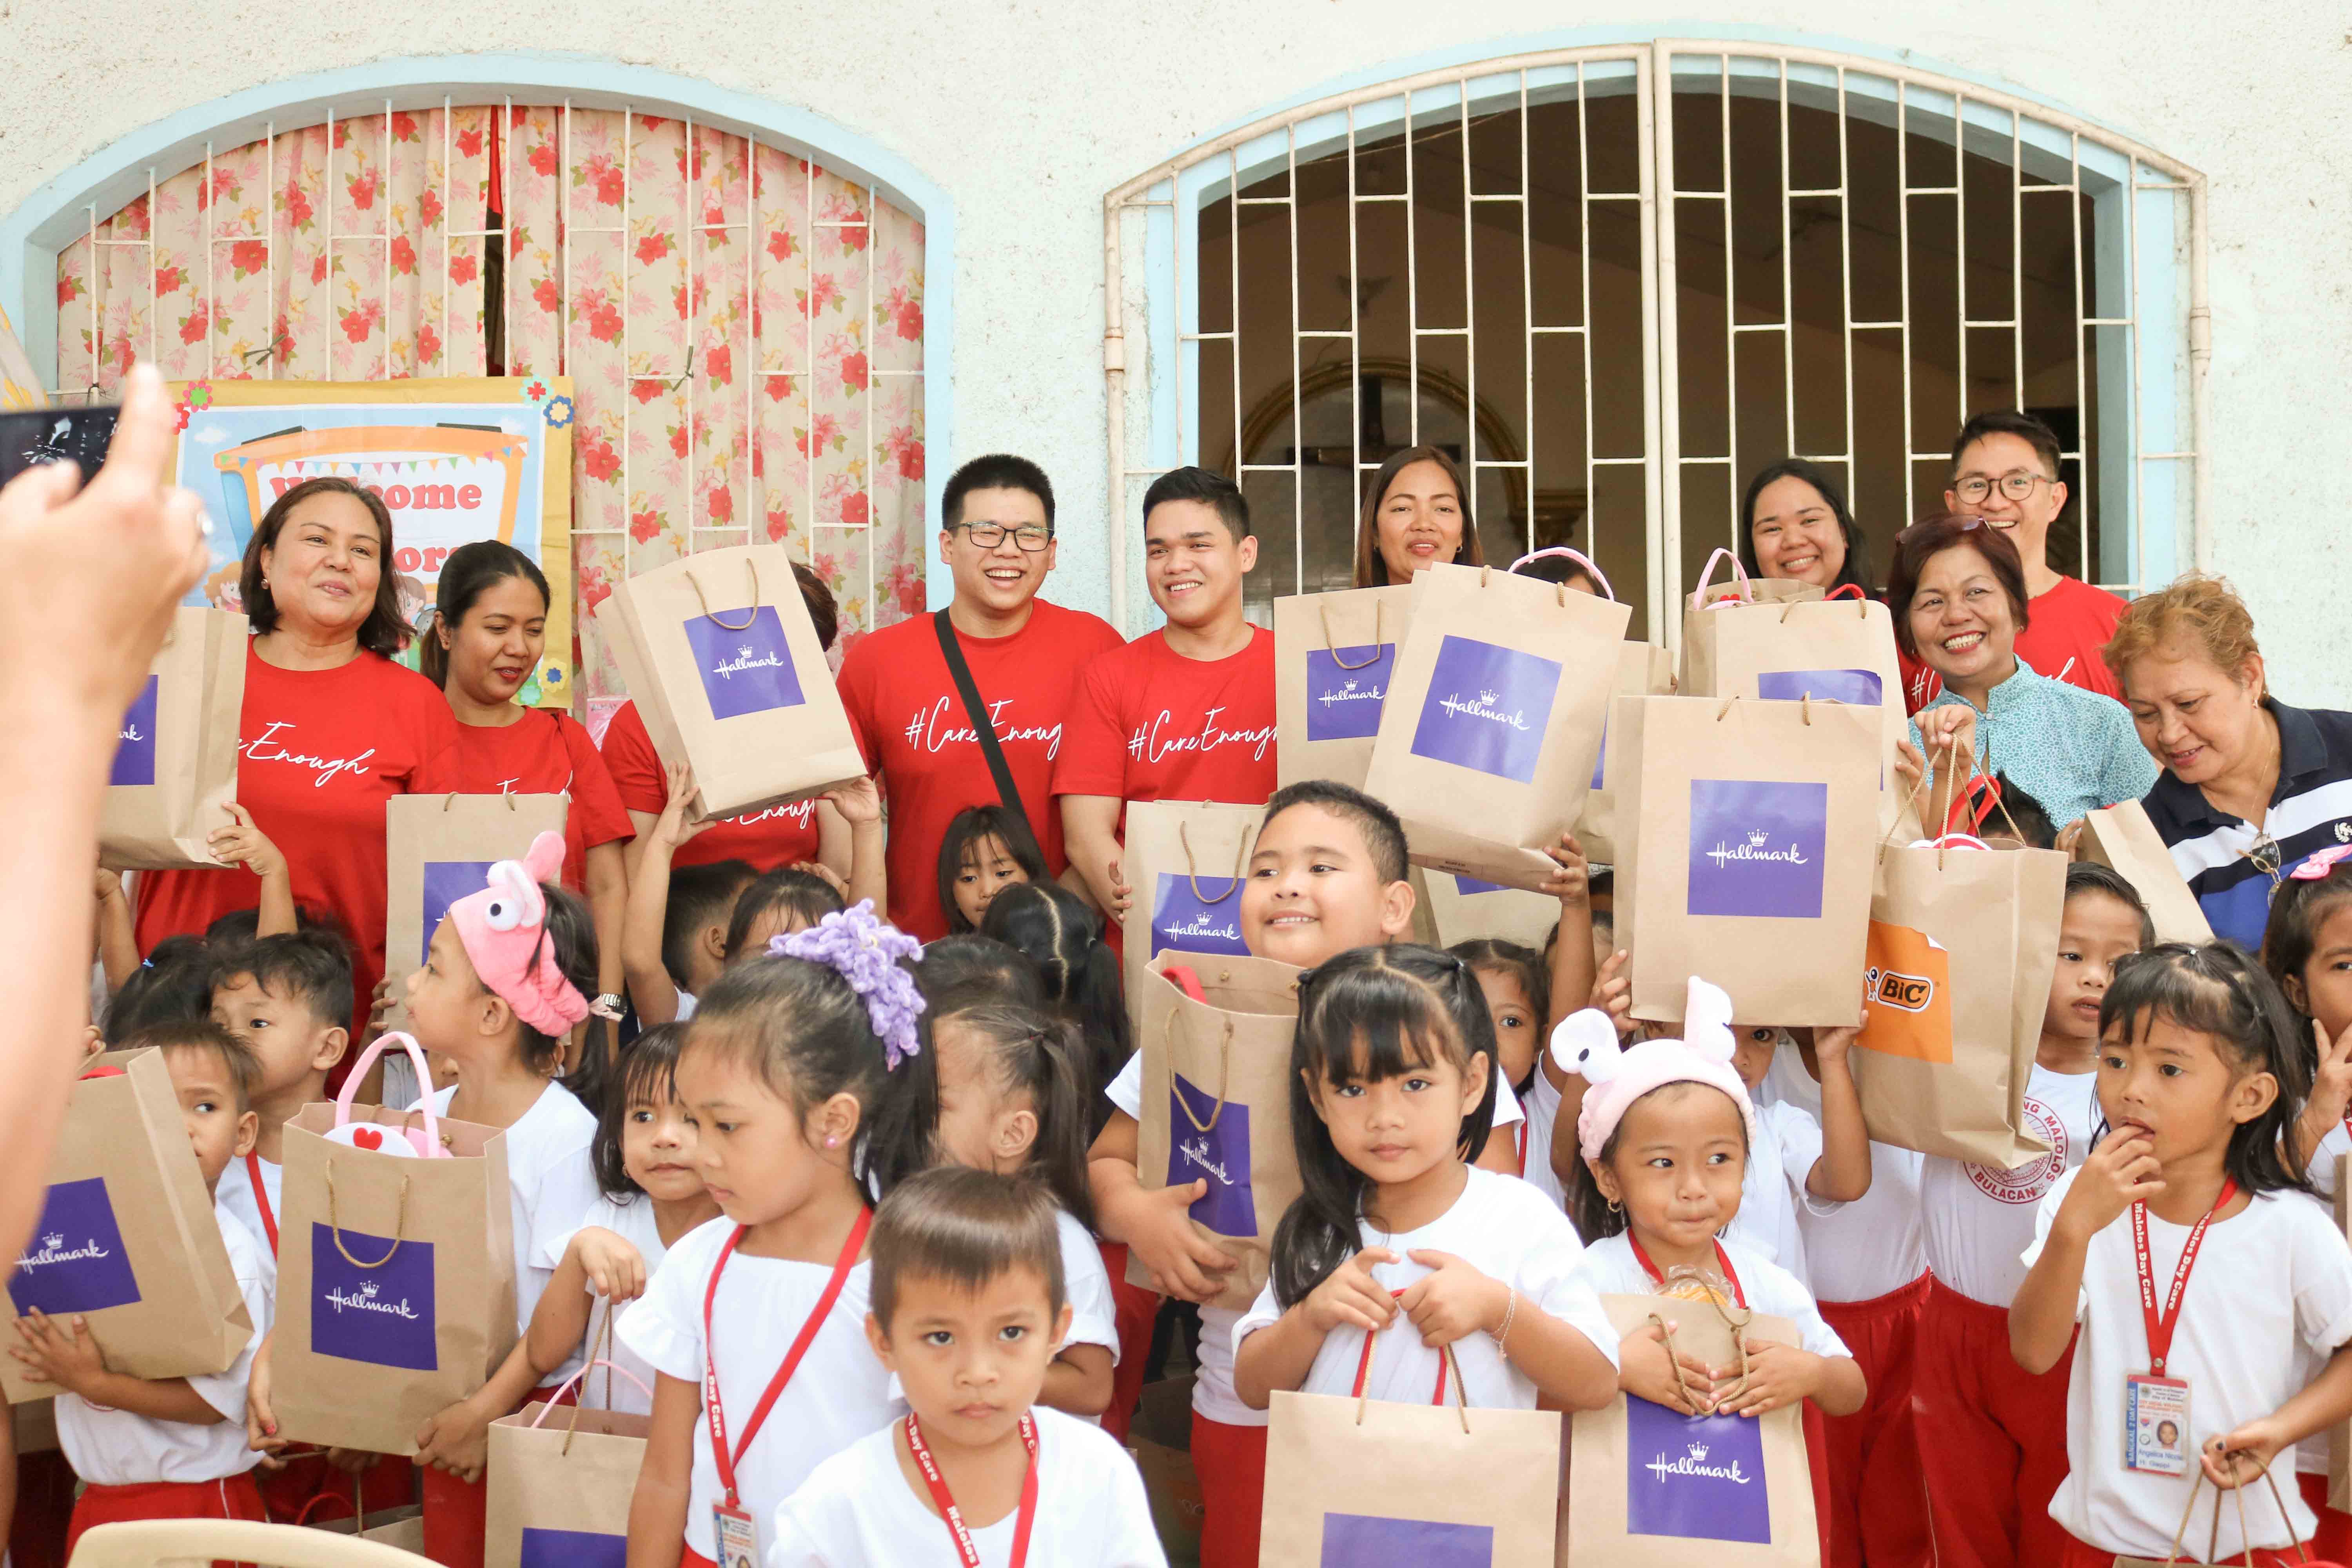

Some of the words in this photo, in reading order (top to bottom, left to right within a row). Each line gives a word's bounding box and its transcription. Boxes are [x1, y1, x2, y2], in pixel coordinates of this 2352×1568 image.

[713, 652, 783, 680] Hallmark
[1318, 686, 1385, 708] Hallmark
[1439, 694, 1530, 730] Hallmark
[905, 696, 1062, 761] #CareEnoug
[1706, 840, 1808, 869] Hallmark
[1164, 920, 1240, 942] Hallmark
[1180, 1138, 1234, 1185] Hallmark
[2044, 1116, 2064, 1182] MALOLOS
[1975, 1172, 2037, 1200] BULACAN
[2134, 1203, 2144, 1250] Malolos
[13, 1239, 109, 1275] Hallmark
[2139, 1252, 2147, 1276] Day
[2176, 1255, 2192, 1279] Day
[325, 1287, 419, 1319] Hallmark
[2142, 1278, 2152, 1308] Care
[2168, 1281, 2182, 1310] Care
[708, 1375, 717, 1403] Day
[711, 1405, 721, 1437] Care
[909, 1425, 922, 1450] Day
[919, 1451, 938, 1481] Care
[1645, 1452, 1750, 1484] Hallmark
[947, 1505, 976, 1564] Malolos
